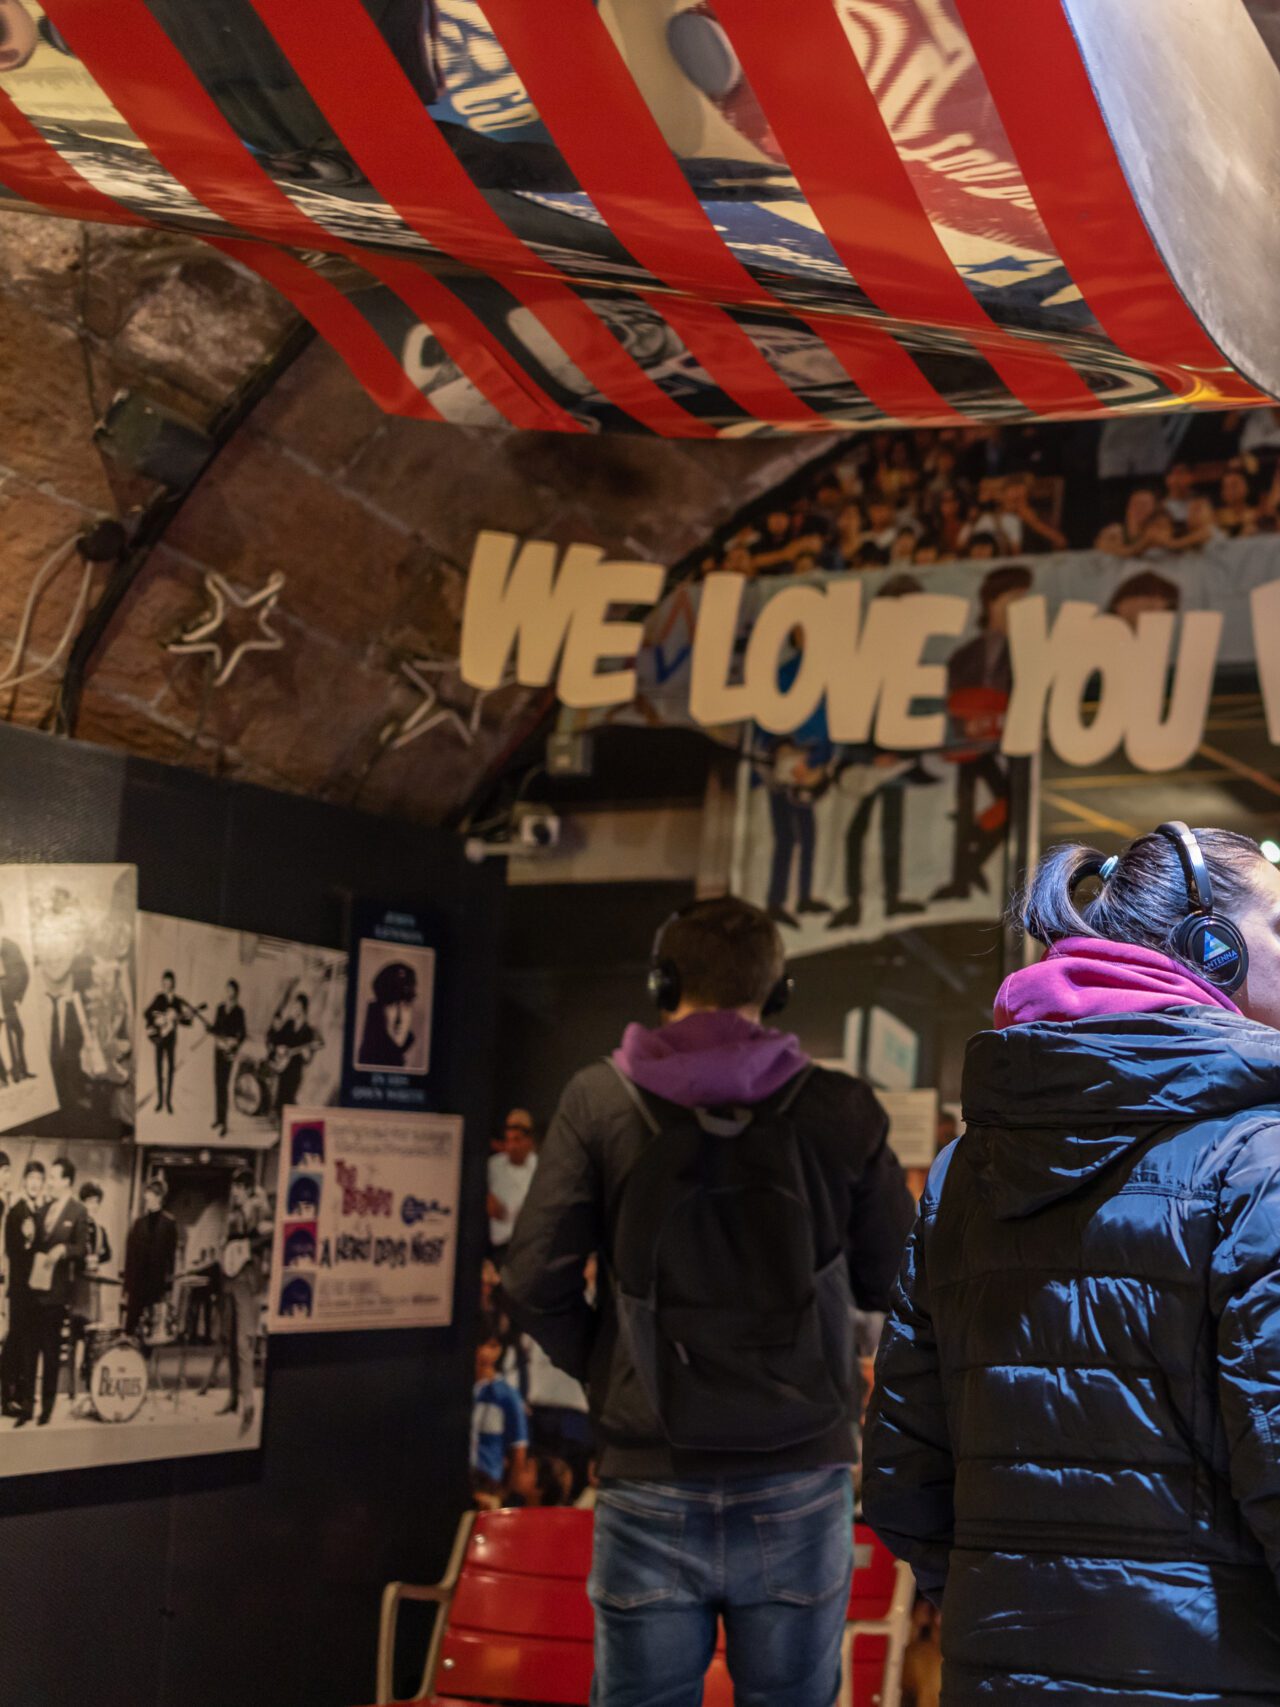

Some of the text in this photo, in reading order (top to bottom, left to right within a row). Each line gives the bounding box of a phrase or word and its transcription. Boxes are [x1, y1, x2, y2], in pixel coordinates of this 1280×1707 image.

[460, 530, 666, 709] WE
[689, 572, 970, 750] LOVE
[1001, 596, 1222, 771] YOU
[1203, 949, 1238, 972] ANTENNA
